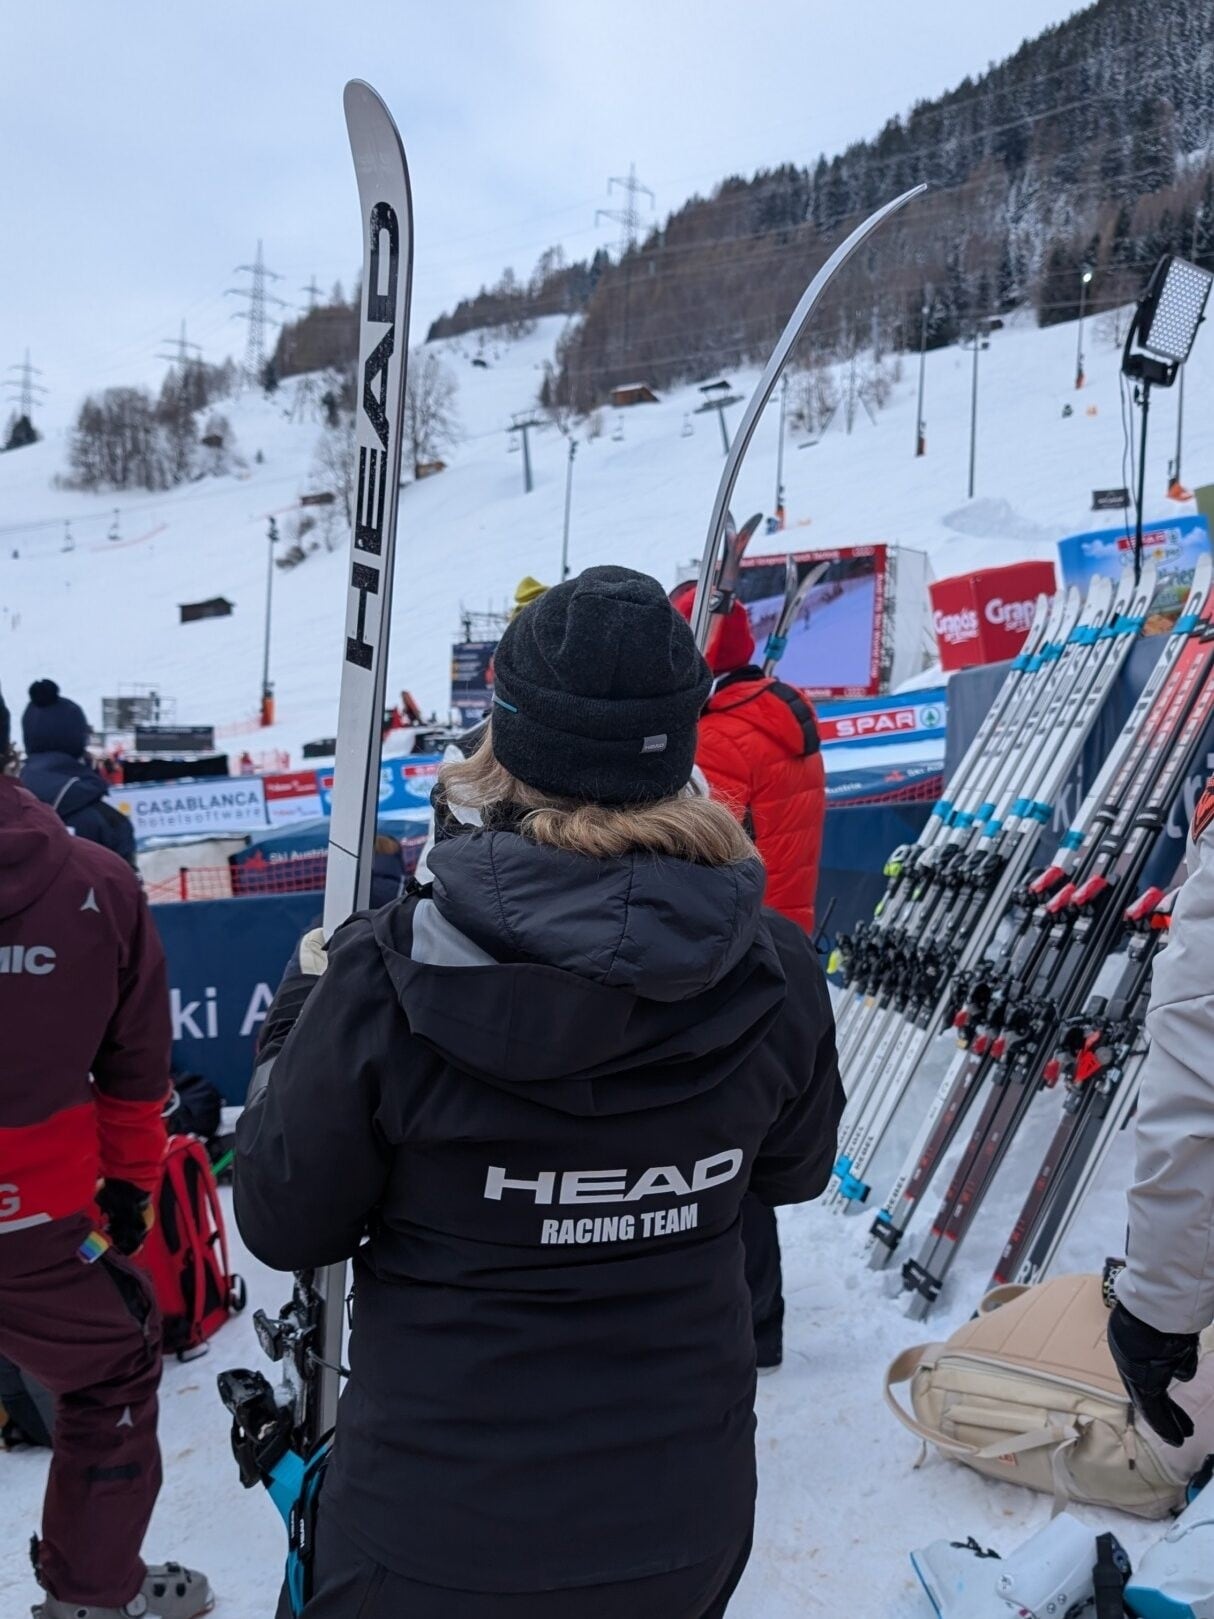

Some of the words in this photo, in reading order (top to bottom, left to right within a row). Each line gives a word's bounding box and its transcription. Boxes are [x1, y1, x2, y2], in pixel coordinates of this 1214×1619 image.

[346, 201, 399, 671] HEAD
[985, 598, 1042, 625] Grap
[836, 711, 914, 737] SPAR
[136, 791, 260, 816] CASABLANCA
[137, 807, 261, 828] hotelsoftware
[169, 986, 218, 1040] ki
[484, 1148, 743, 1205] HEAD
[540, 1214, 635, 1245] RACING
[640, 1202, 698, 1238] TEAM
